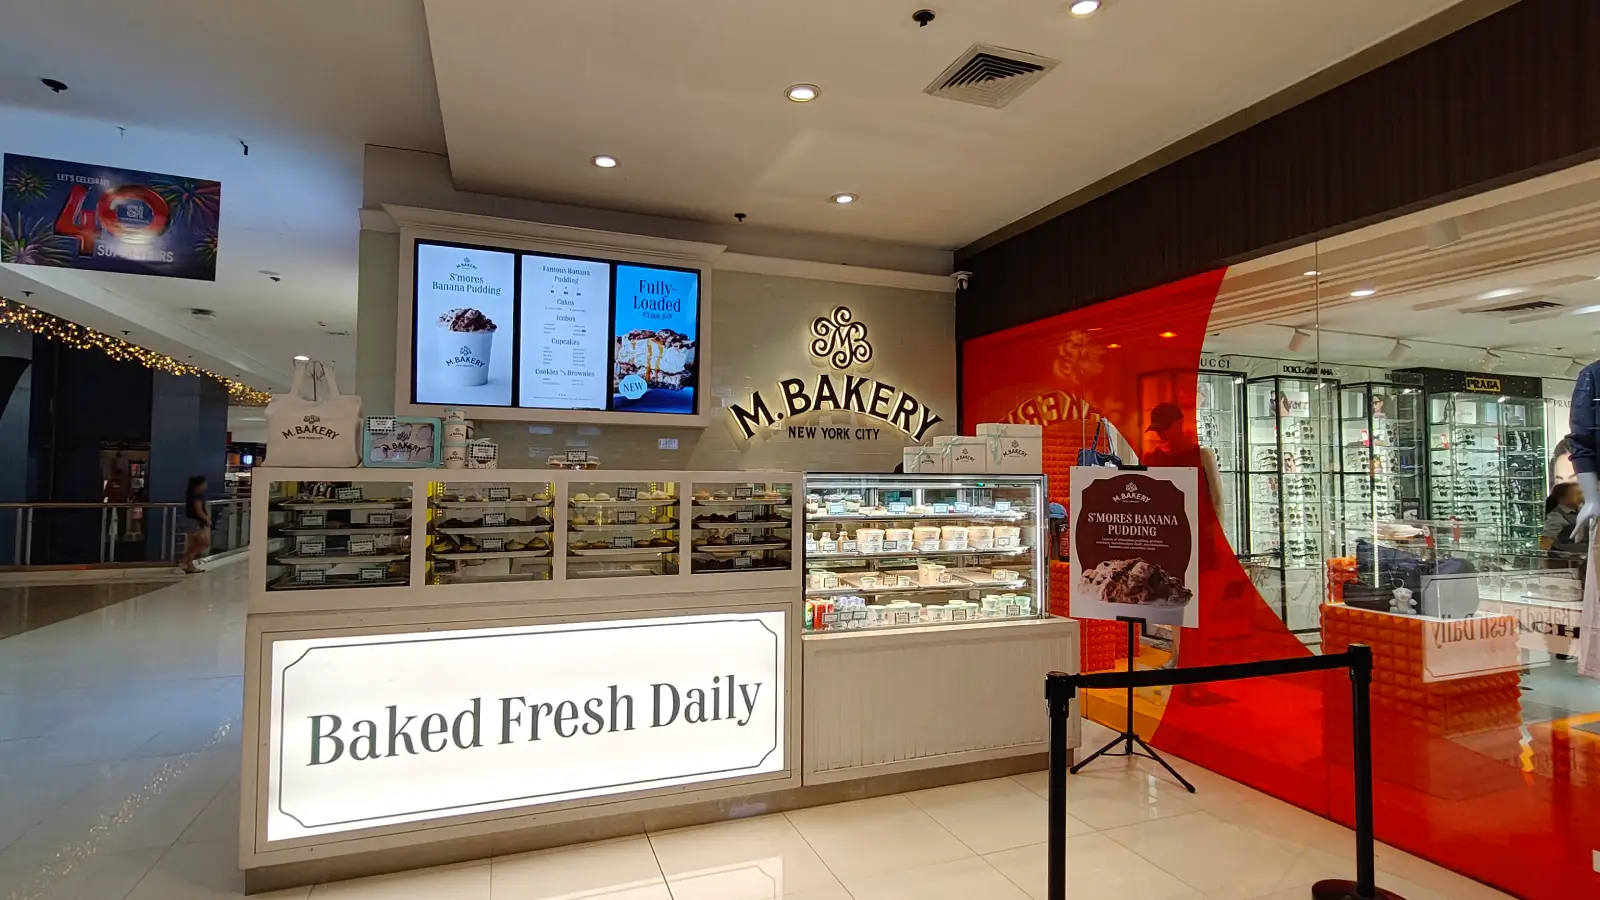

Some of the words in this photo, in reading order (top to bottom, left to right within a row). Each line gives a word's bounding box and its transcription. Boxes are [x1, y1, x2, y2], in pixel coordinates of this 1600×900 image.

[542, 265, 567, 274] Famous
[567, 267, 591, 276] Banana
[449, 272, 484, 284] S'mores
[554, 275, 580, 284] Pudding
[432, 281, 465, 292] Banana
[466, 284, 502, 296] Pudding
[639, 279, 677, 297] Fully-
[556, 298, 575, 306] Cakes
[633, 295, 681, 313] Loaded
[551, 337, 580, 346] Cupcakes
[445, 356, 486, 368] M.BAKERY
[1200, 358, 1230, 369] UCCI
[535, 368, 559, 376] Cookies
[567, 369, 595, 377] Brownies
[622, 382, 644, 392] NEW
[728, 374, 944, 443] M.BAKERY
[282, 425, 341, 439] M.BAKERY
[788, 426, 817, 439] NEW
[820, 426, 851, 441] YORK
[855, 428, 880, 441] CITY
[1112, 492, 1152, 503] M.BAKERY
[1087, 512, 1133, 524] S'MORES
[1134, 514, 1179, 526] BANANA
[1108, 524, 1157, 537] PUDDING
[305, 697, 484, 767] Baked
[497, 685, 636, 746] Fresh
[649, 674, 763, 728] Daily
